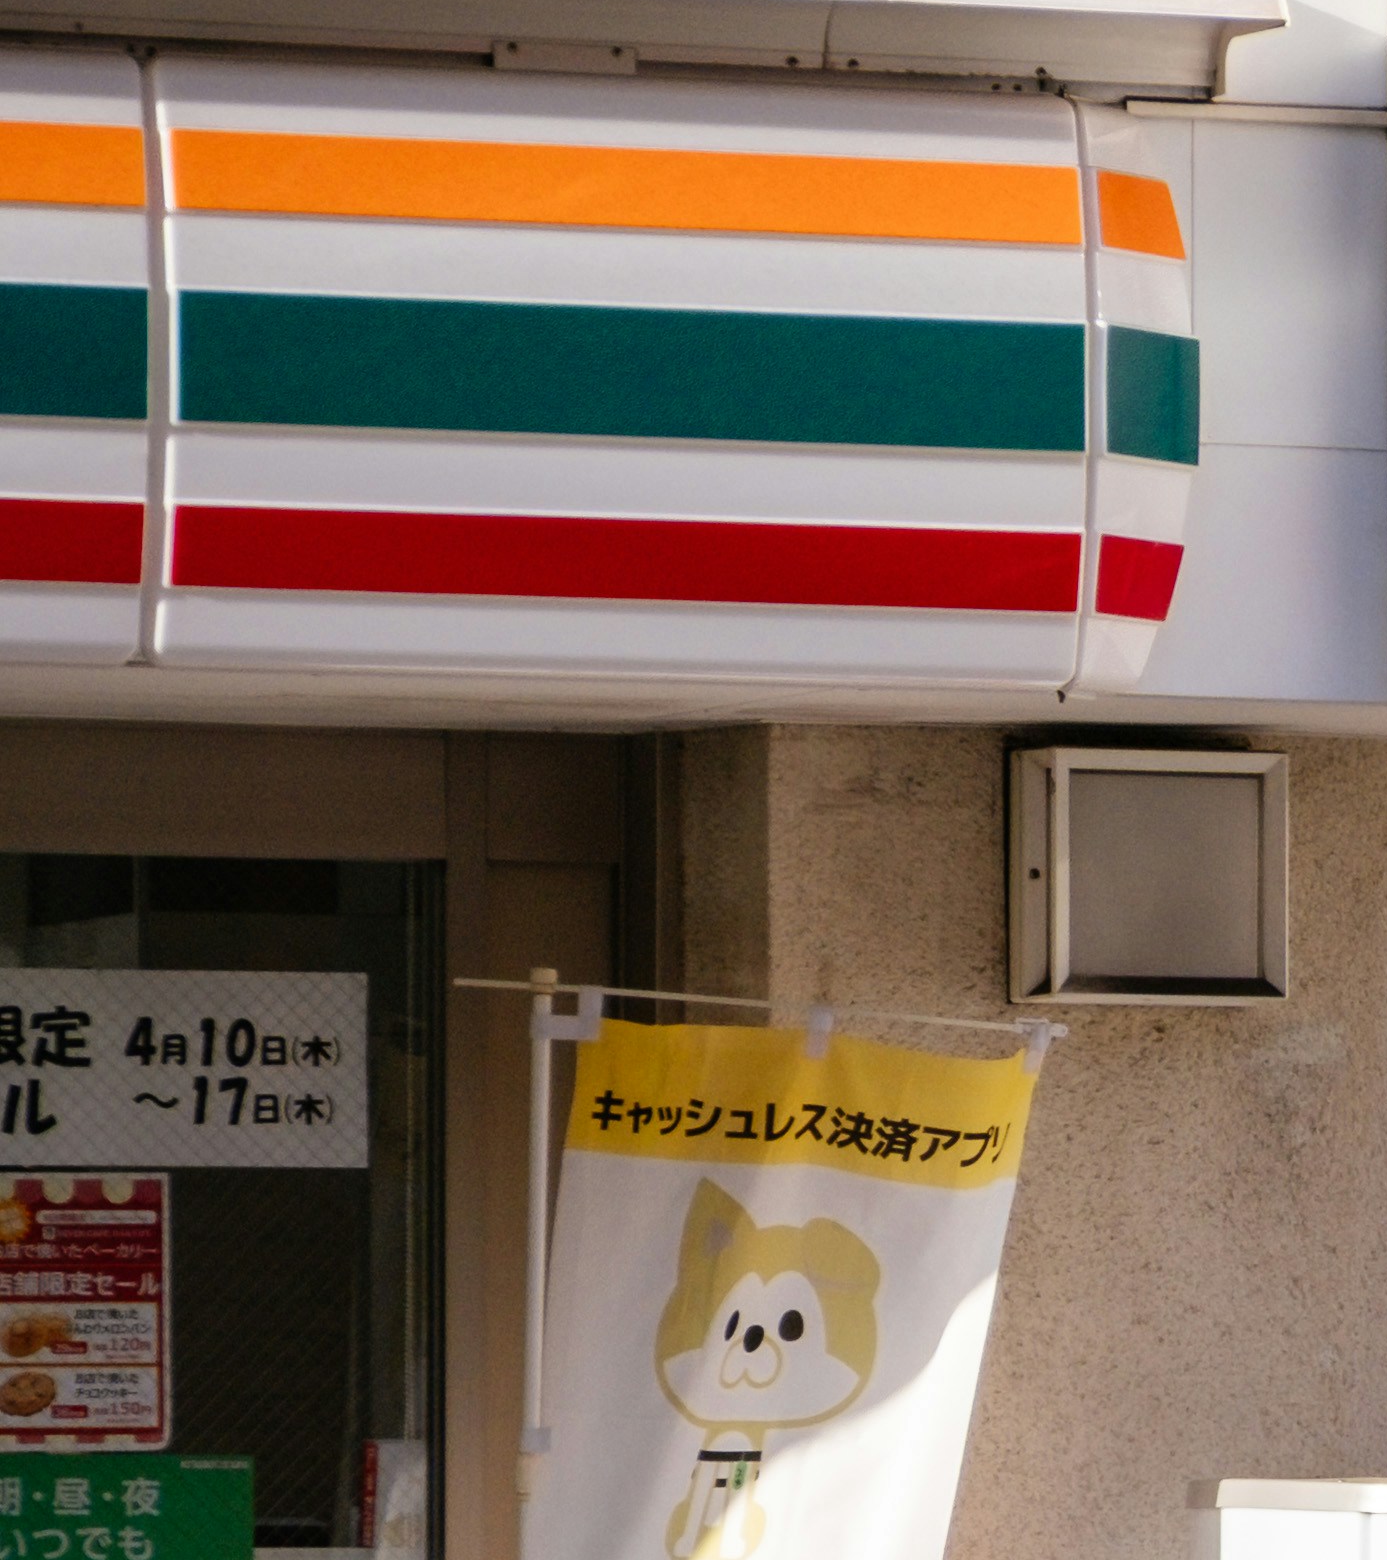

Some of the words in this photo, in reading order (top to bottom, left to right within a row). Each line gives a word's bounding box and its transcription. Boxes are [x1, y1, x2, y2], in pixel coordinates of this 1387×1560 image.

[591, 1090, 1012, 1168] キャッシュレス決済アプリ
